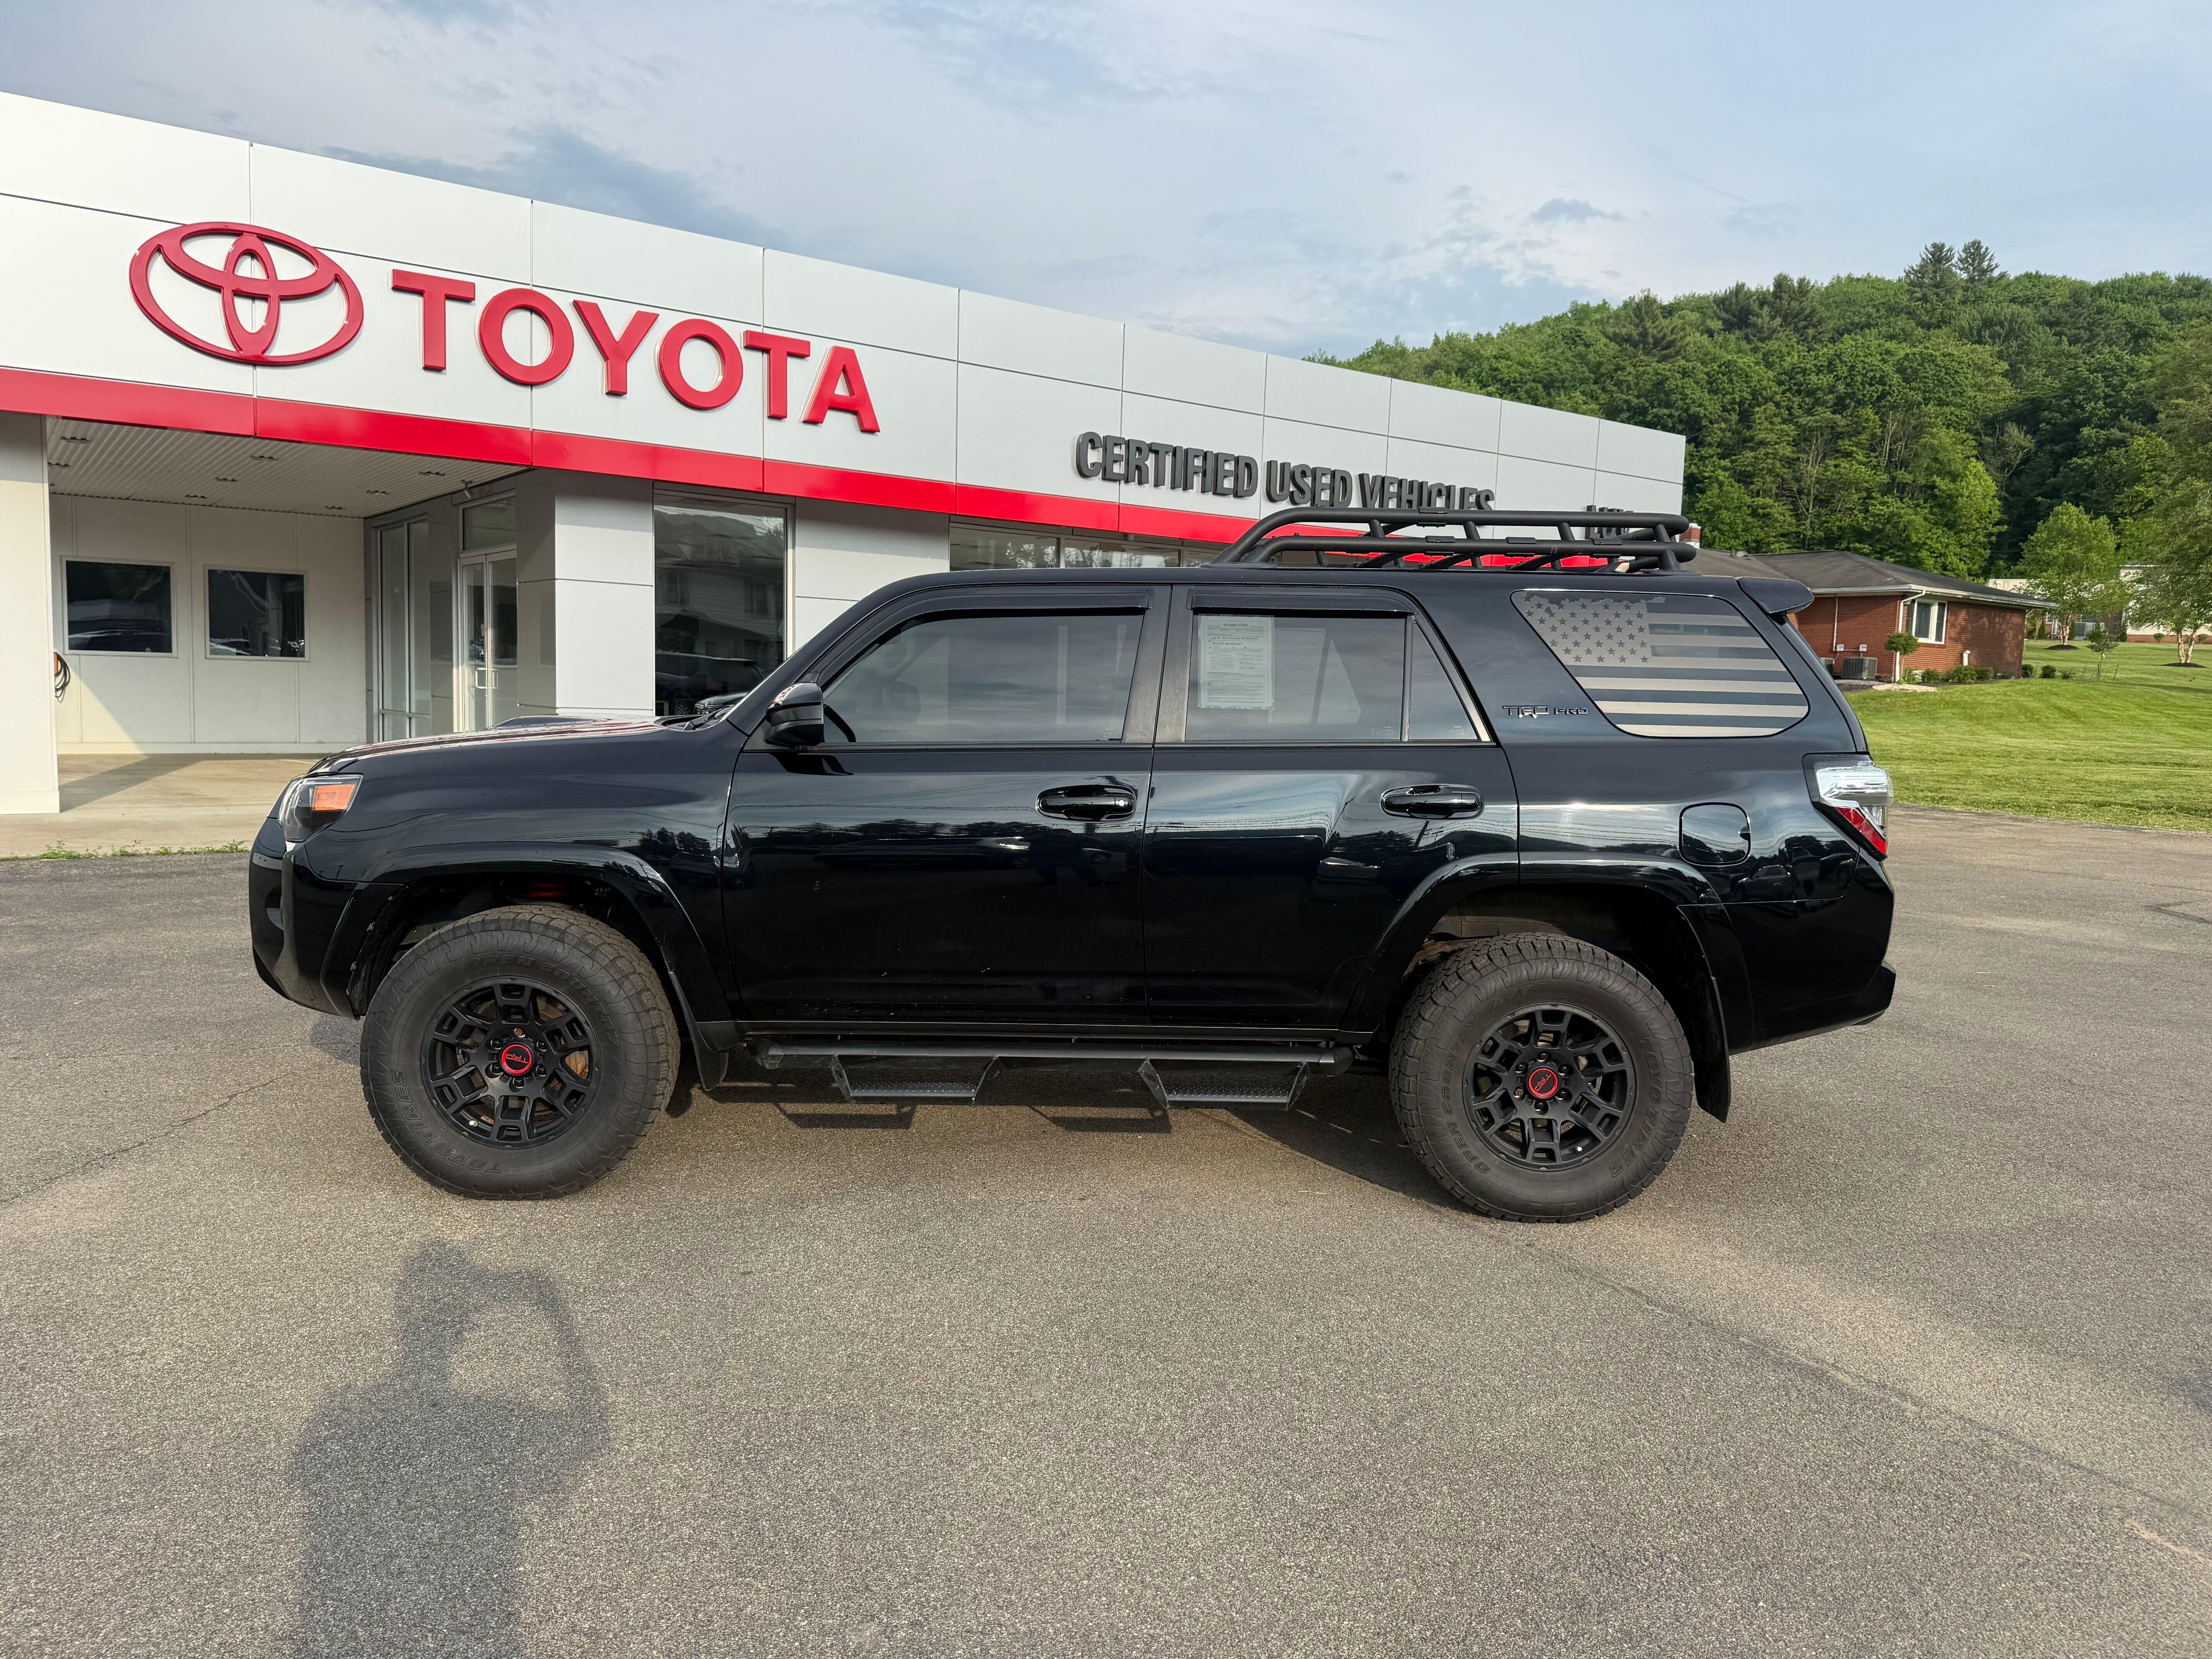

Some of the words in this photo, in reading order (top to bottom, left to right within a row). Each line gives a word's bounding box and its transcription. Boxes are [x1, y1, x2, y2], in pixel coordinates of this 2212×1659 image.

[391, 269, 880, 433] TOYOTA
[1076, 431, 1259, 498] CERTIFIED
[1266, 460, 1353, 508] USED
[1502, 705, 1549, 719] TRD
[1554, 707, 1588, 715] PRO
[465, 955, 535, 971] OPEN
[505, 1053, 528, 1064] TRD
[1534, 1073, 1552, 1092] TRD
[1638, 1037, 1662, 1104] TOYO
[391, 1069, 437, 1143] TIRES
[434, 1142, 502, 1173] TOYO
[1447, 1121, 1491, 1174] OPEN
[1609, 1108, 1659, 1178] TIRES
